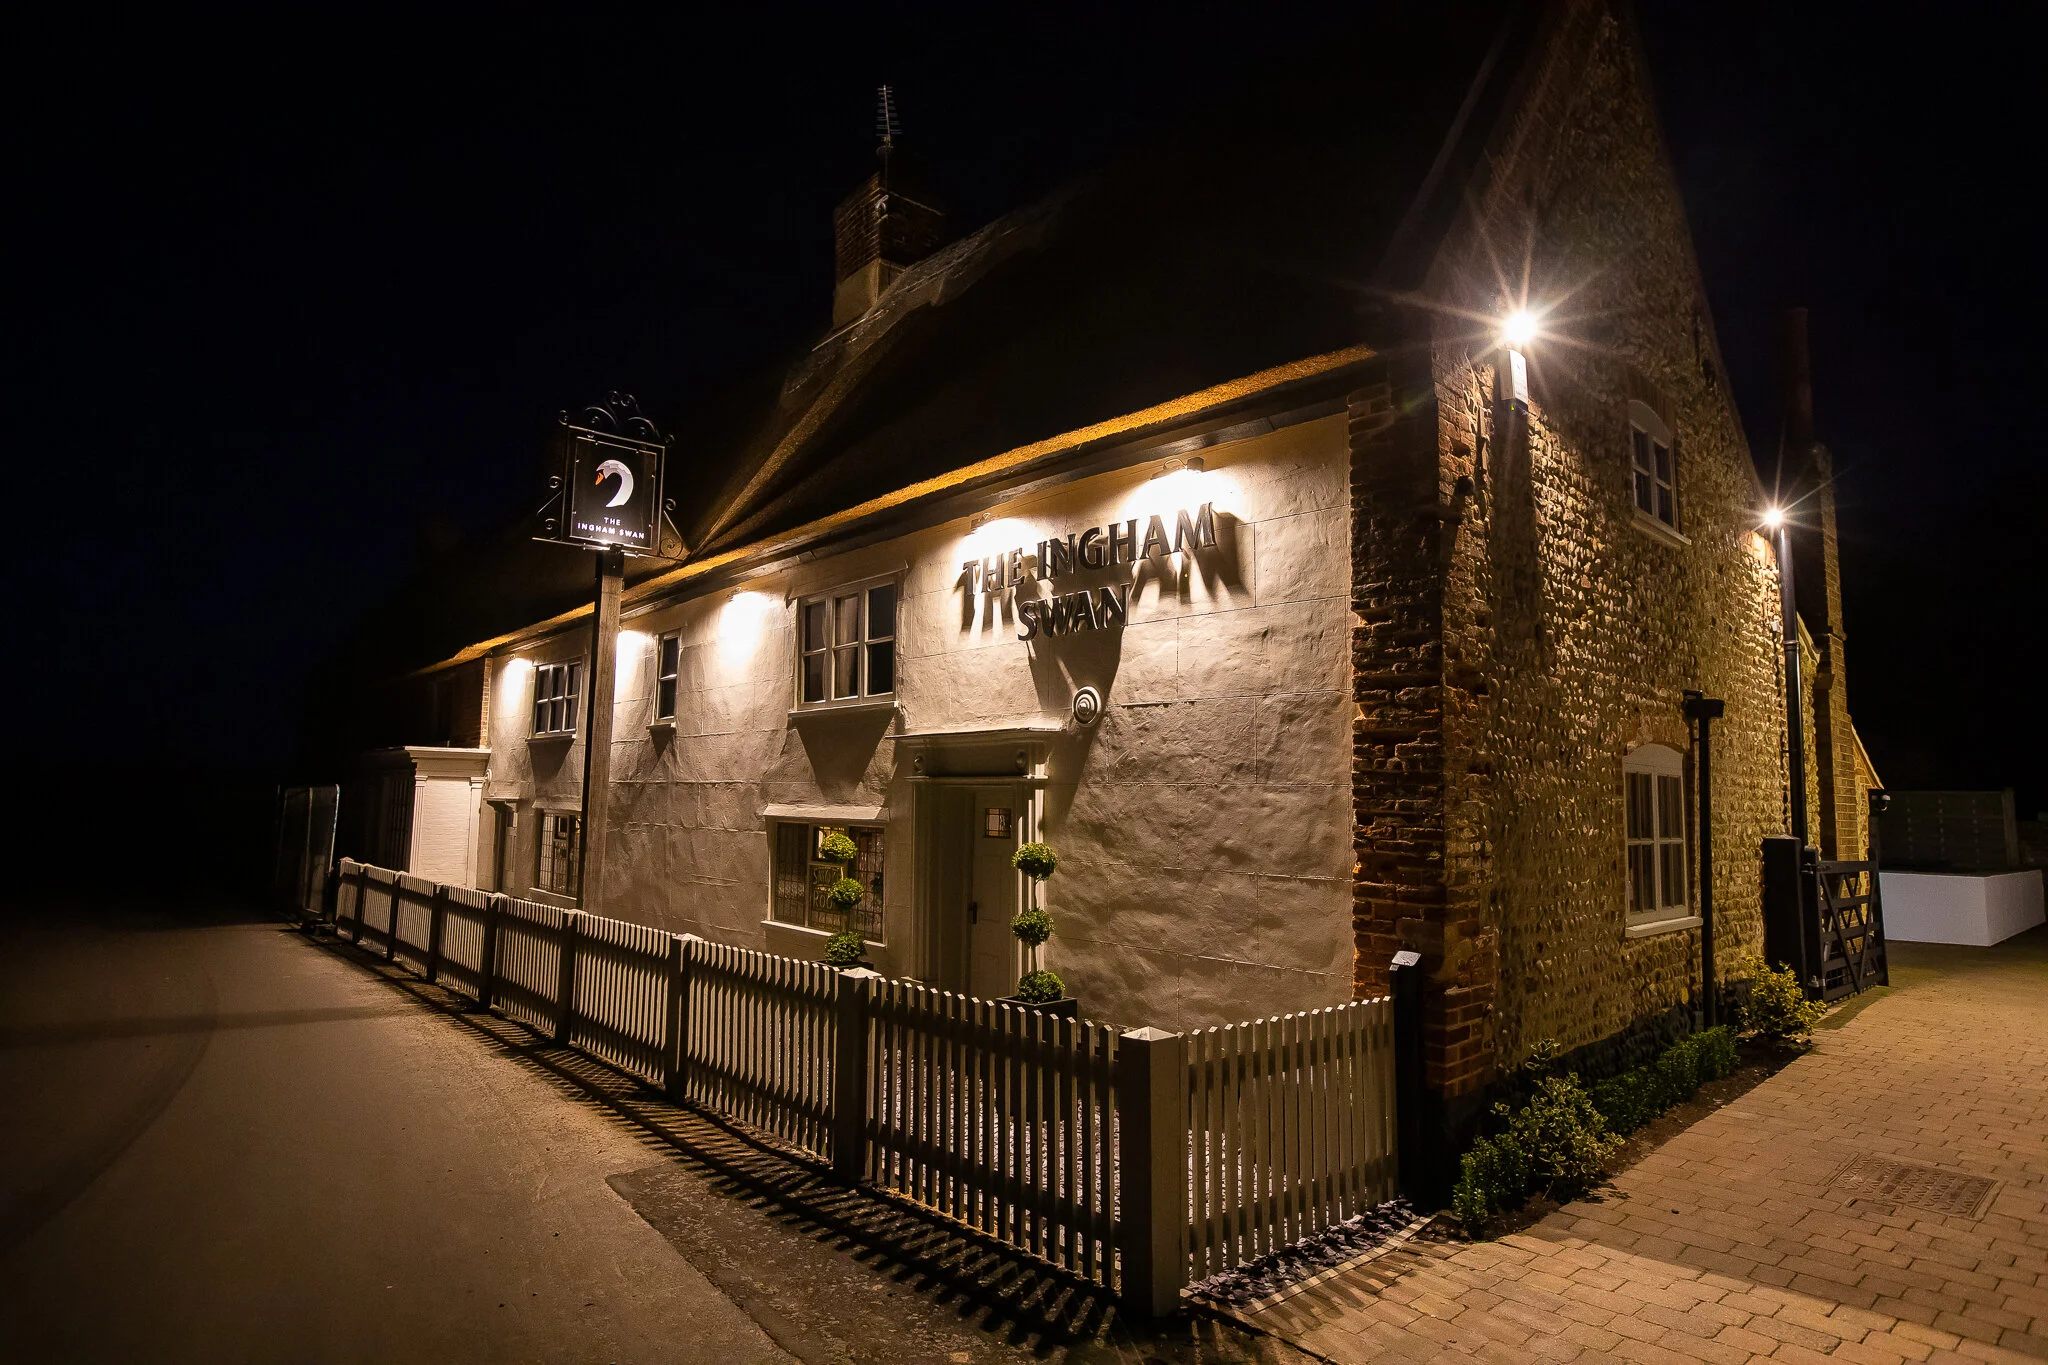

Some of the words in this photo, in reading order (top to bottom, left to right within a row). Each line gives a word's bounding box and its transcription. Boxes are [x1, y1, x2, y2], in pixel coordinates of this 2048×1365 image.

[577, 522, 616, 535] INGHAM
[619, 529, 645, 540] SWAN
[604, 517, 621, 526] THE
[963, 547, 1025, 596] THE
[1037, 501, 1217, 581] INGHAM
[1017, 582, 1130, 642] SWAN
